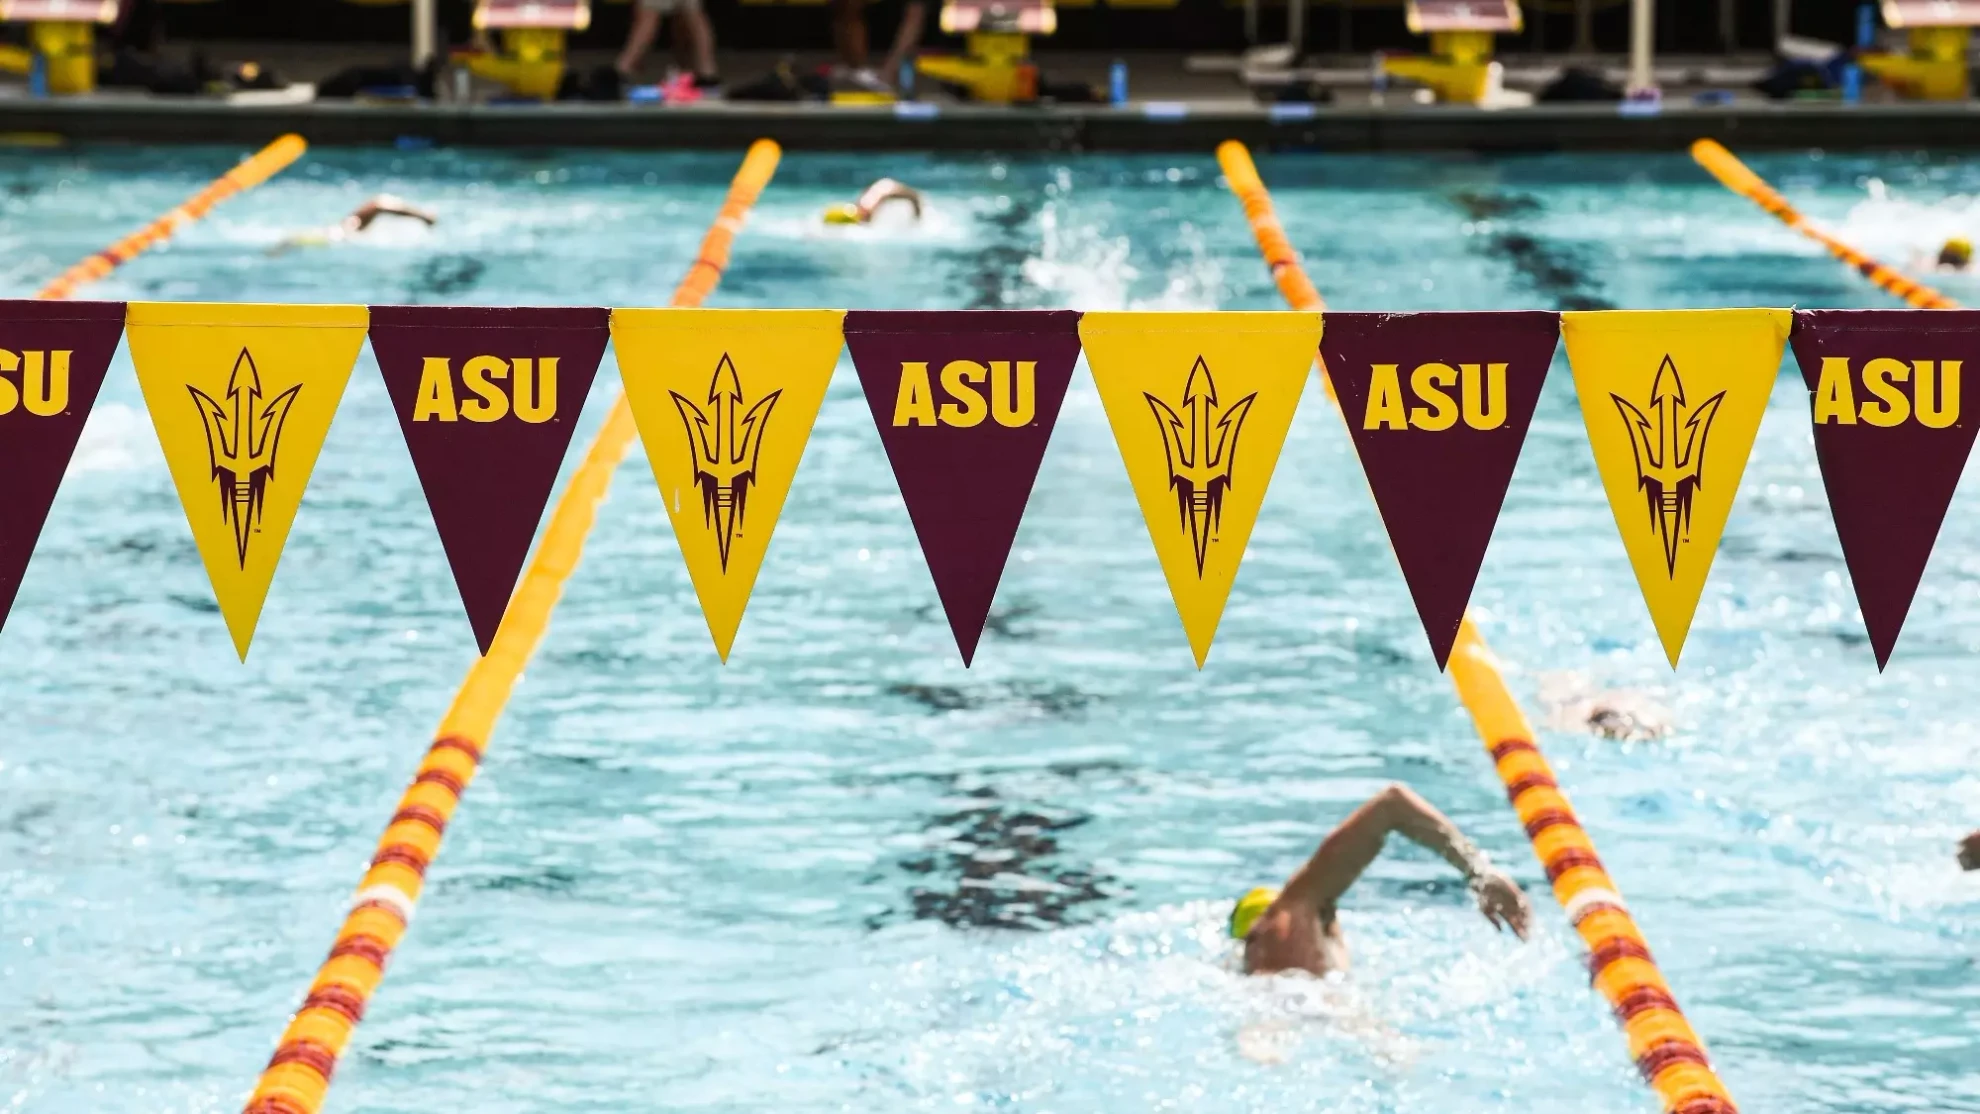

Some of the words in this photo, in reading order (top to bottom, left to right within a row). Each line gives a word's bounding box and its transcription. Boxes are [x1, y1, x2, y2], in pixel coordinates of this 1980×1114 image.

[413, 354, 558, 423] ASU
[892, 360, 1036, 428] ASU
[1364, 362, 1508, 431] ASU
[1815, 356, 1963, 429] ASU
